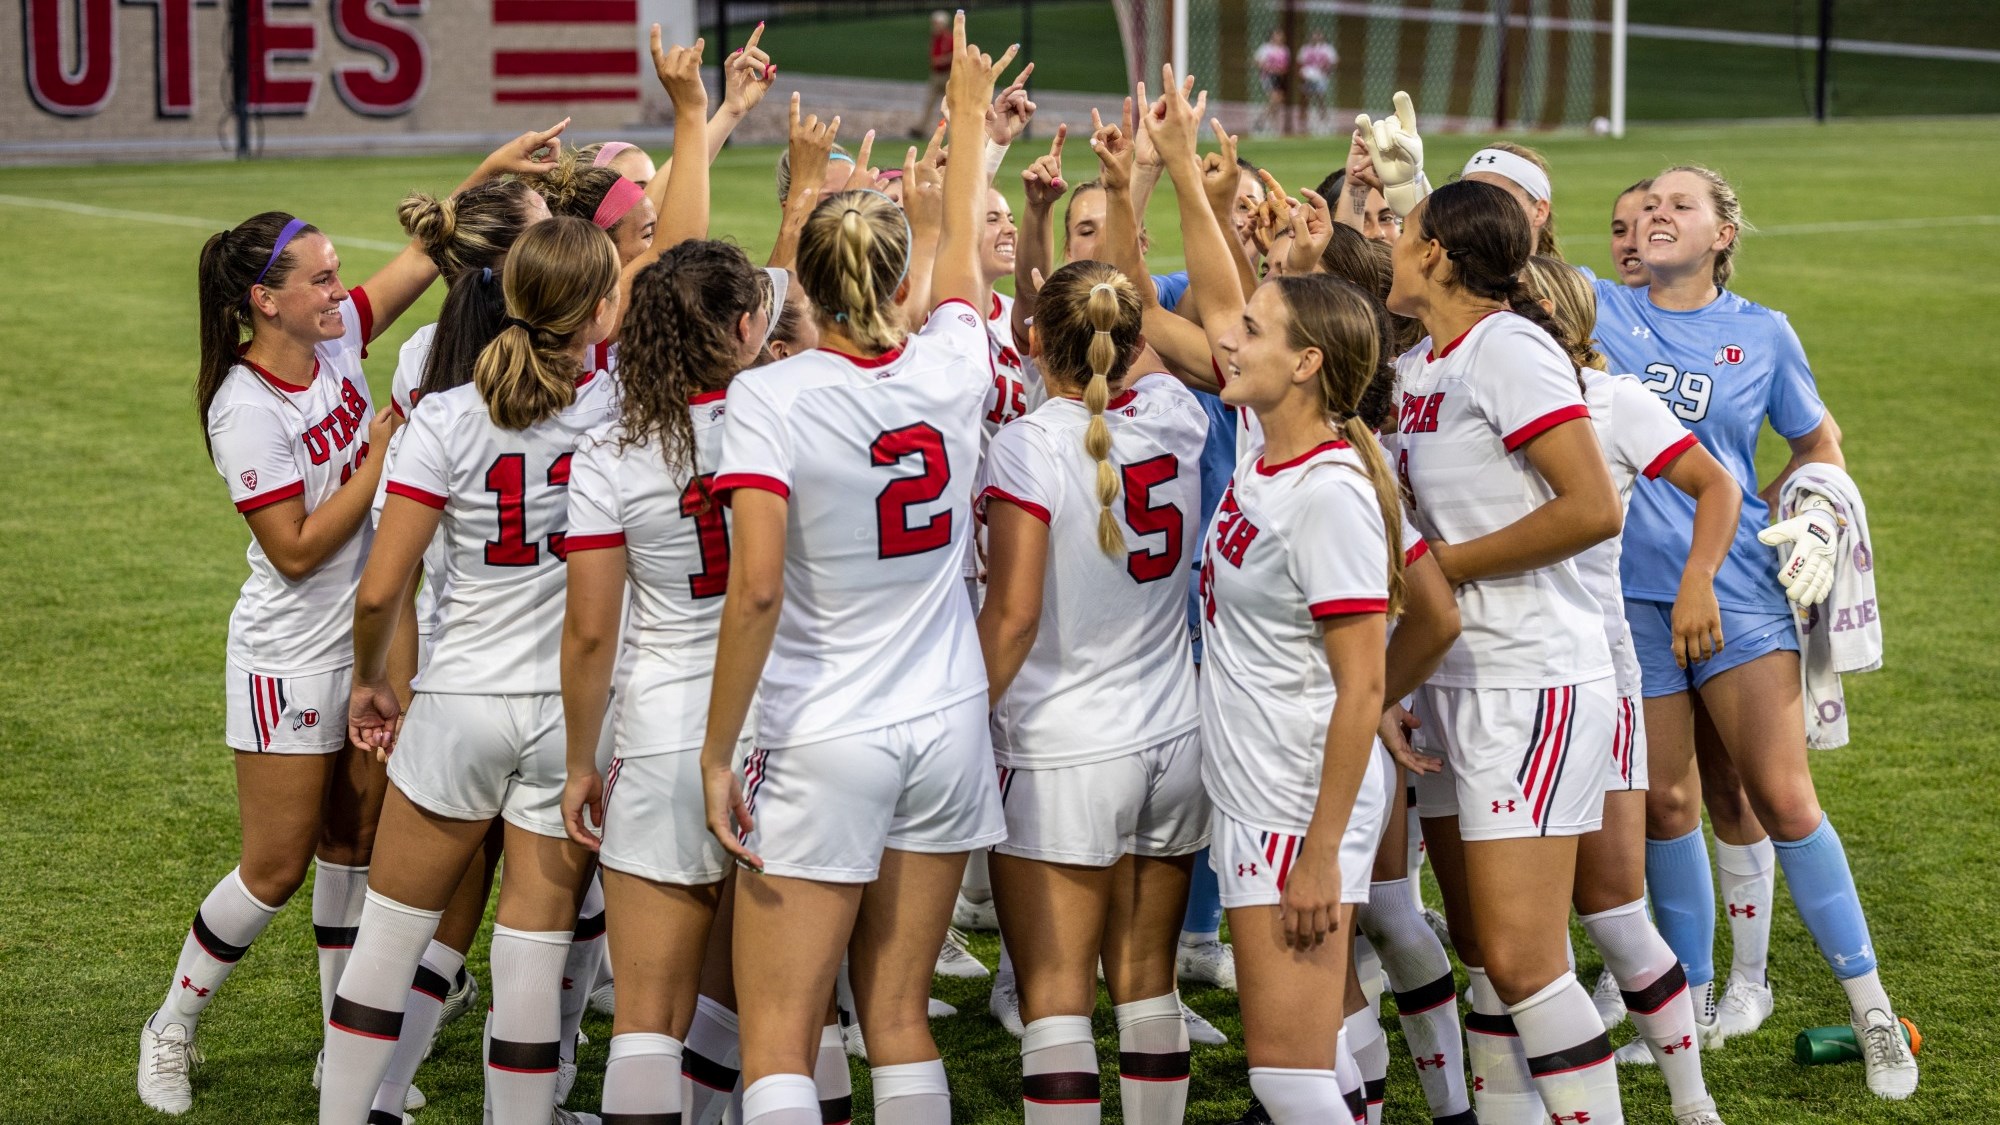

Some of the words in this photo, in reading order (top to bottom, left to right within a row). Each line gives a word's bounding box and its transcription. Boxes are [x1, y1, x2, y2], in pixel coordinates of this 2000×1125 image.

[20, 0, 431, 119] UTES
[1642, 362, 1713, 423] 29
[1726, 348, 1741, 363] U
[301, 376, 367, 466] UTAH
[869, 421, 952, 560] 2
[1121, 453, 1183, 584] 5
[304, 712, 317, 725] U
